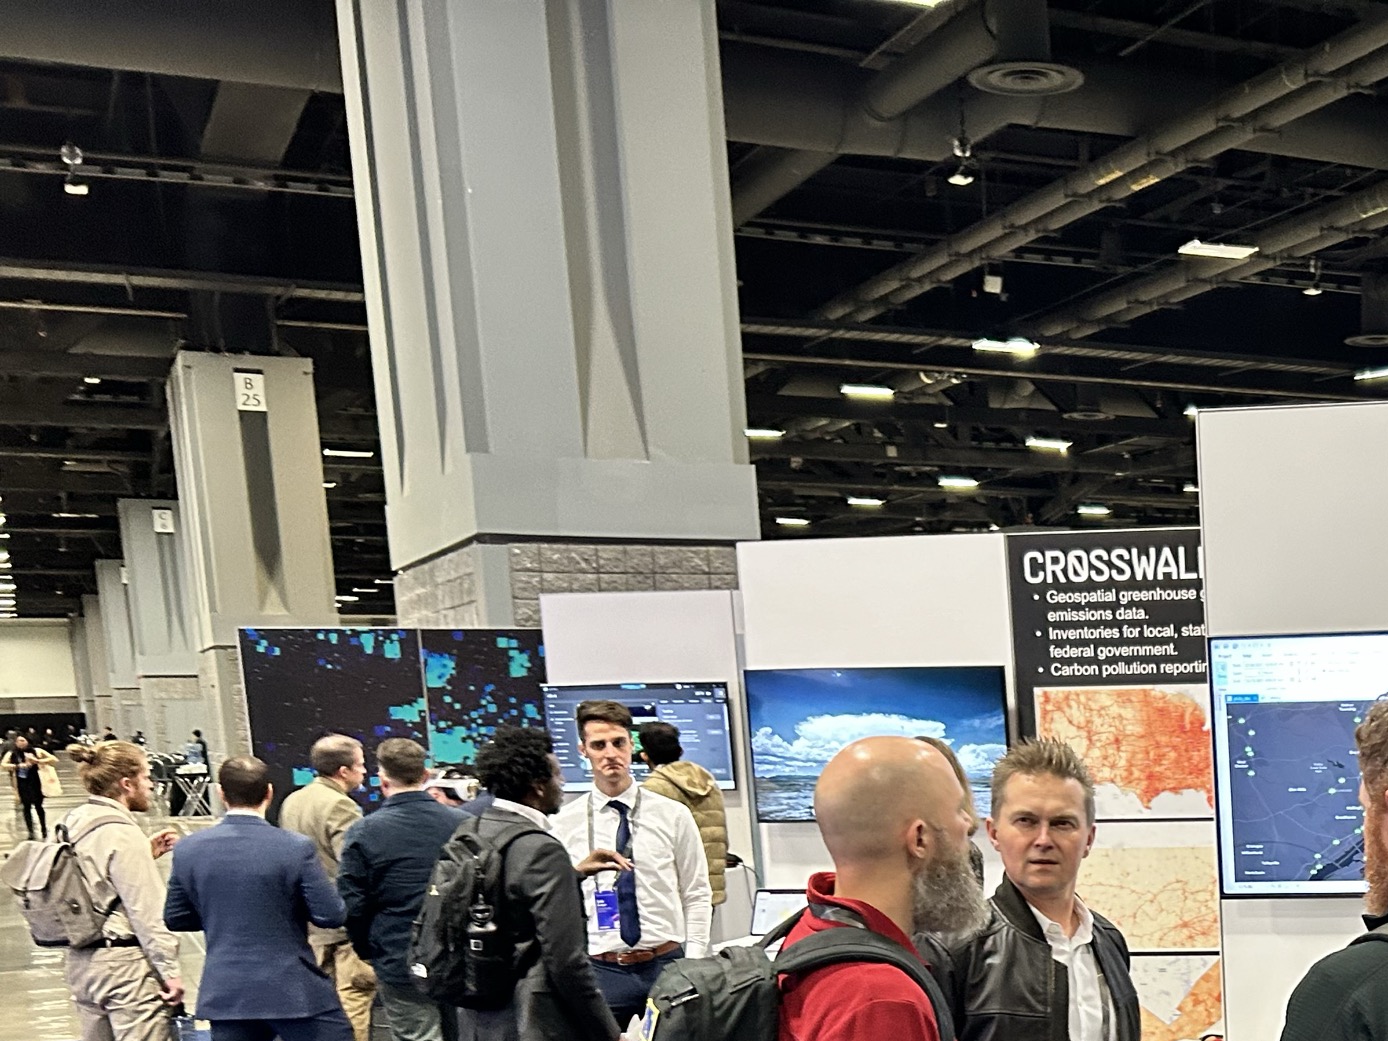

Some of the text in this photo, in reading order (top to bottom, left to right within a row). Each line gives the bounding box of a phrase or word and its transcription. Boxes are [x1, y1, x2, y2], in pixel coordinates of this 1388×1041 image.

[244, 378, 253, 390] B
[241, 394, 261, 407] 25
[1046, 589, 1116, 605] Geospatial
[1118, 587, 1197, 605] greenhouse
[1047, 607, 1149, 622] emissions data.
[1049, 624, 1205, 640] Inventories for local, stat
[1049, 642, 1178, 659] federal government.
[1050, 663, 1100, 677] Carbon
[1102, 661, 1157, 678] pollution
